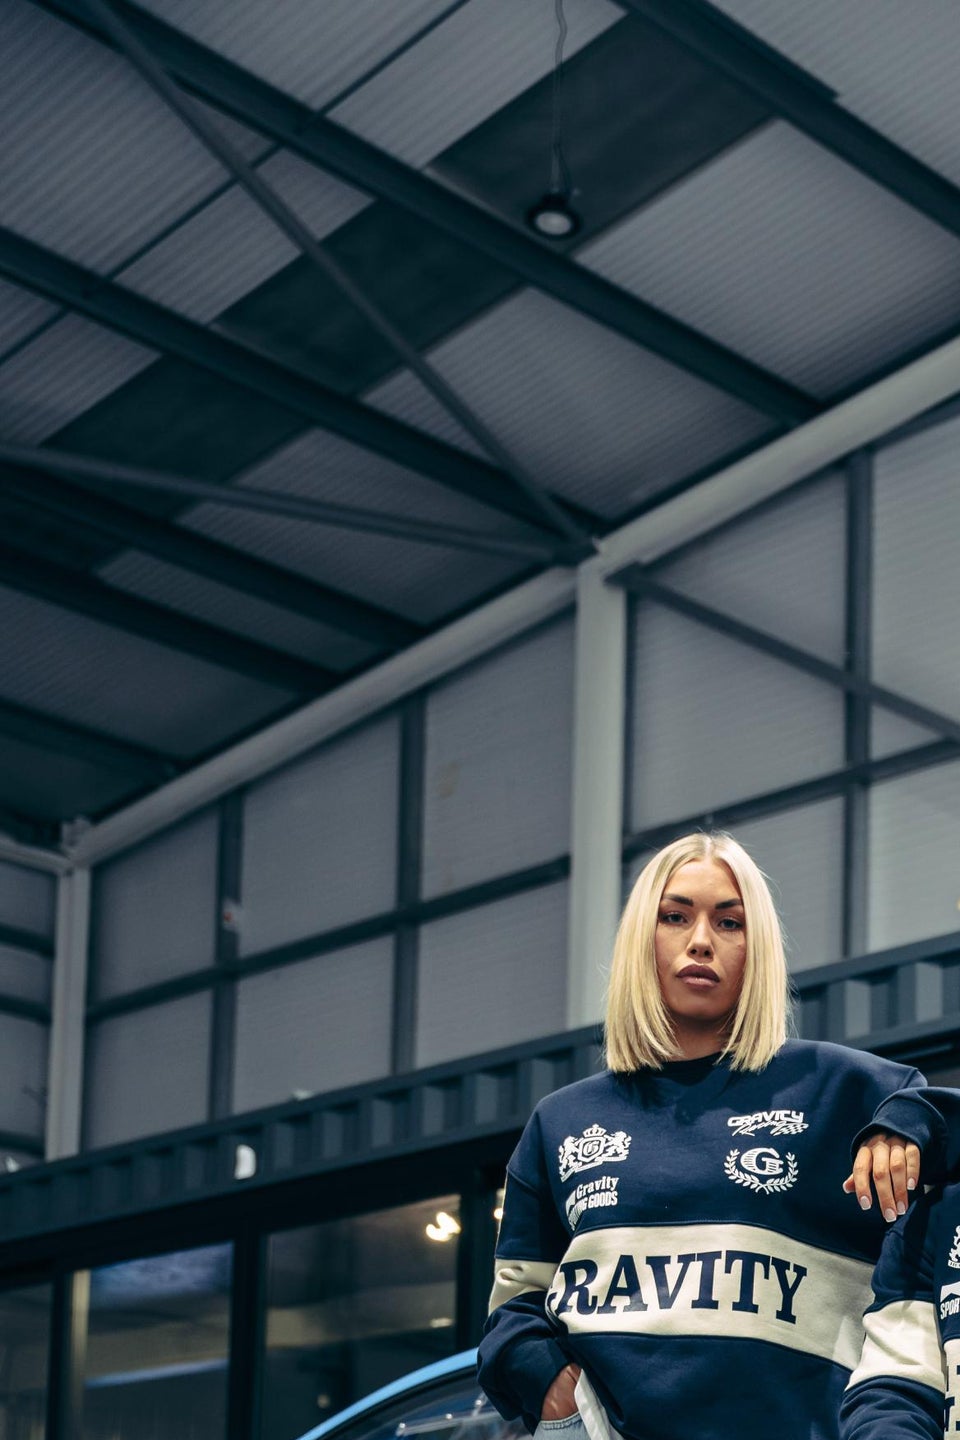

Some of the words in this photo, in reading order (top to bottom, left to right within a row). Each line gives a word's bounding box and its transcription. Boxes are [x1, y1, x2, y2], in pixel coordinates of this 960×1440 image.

[740, 1147, 784, 1176] G
[576, 1175, 620, 1200] Gravity
[588, 1190, 619, 1209] GOODS
[548, 1249, 808, 1325] RAVITY
